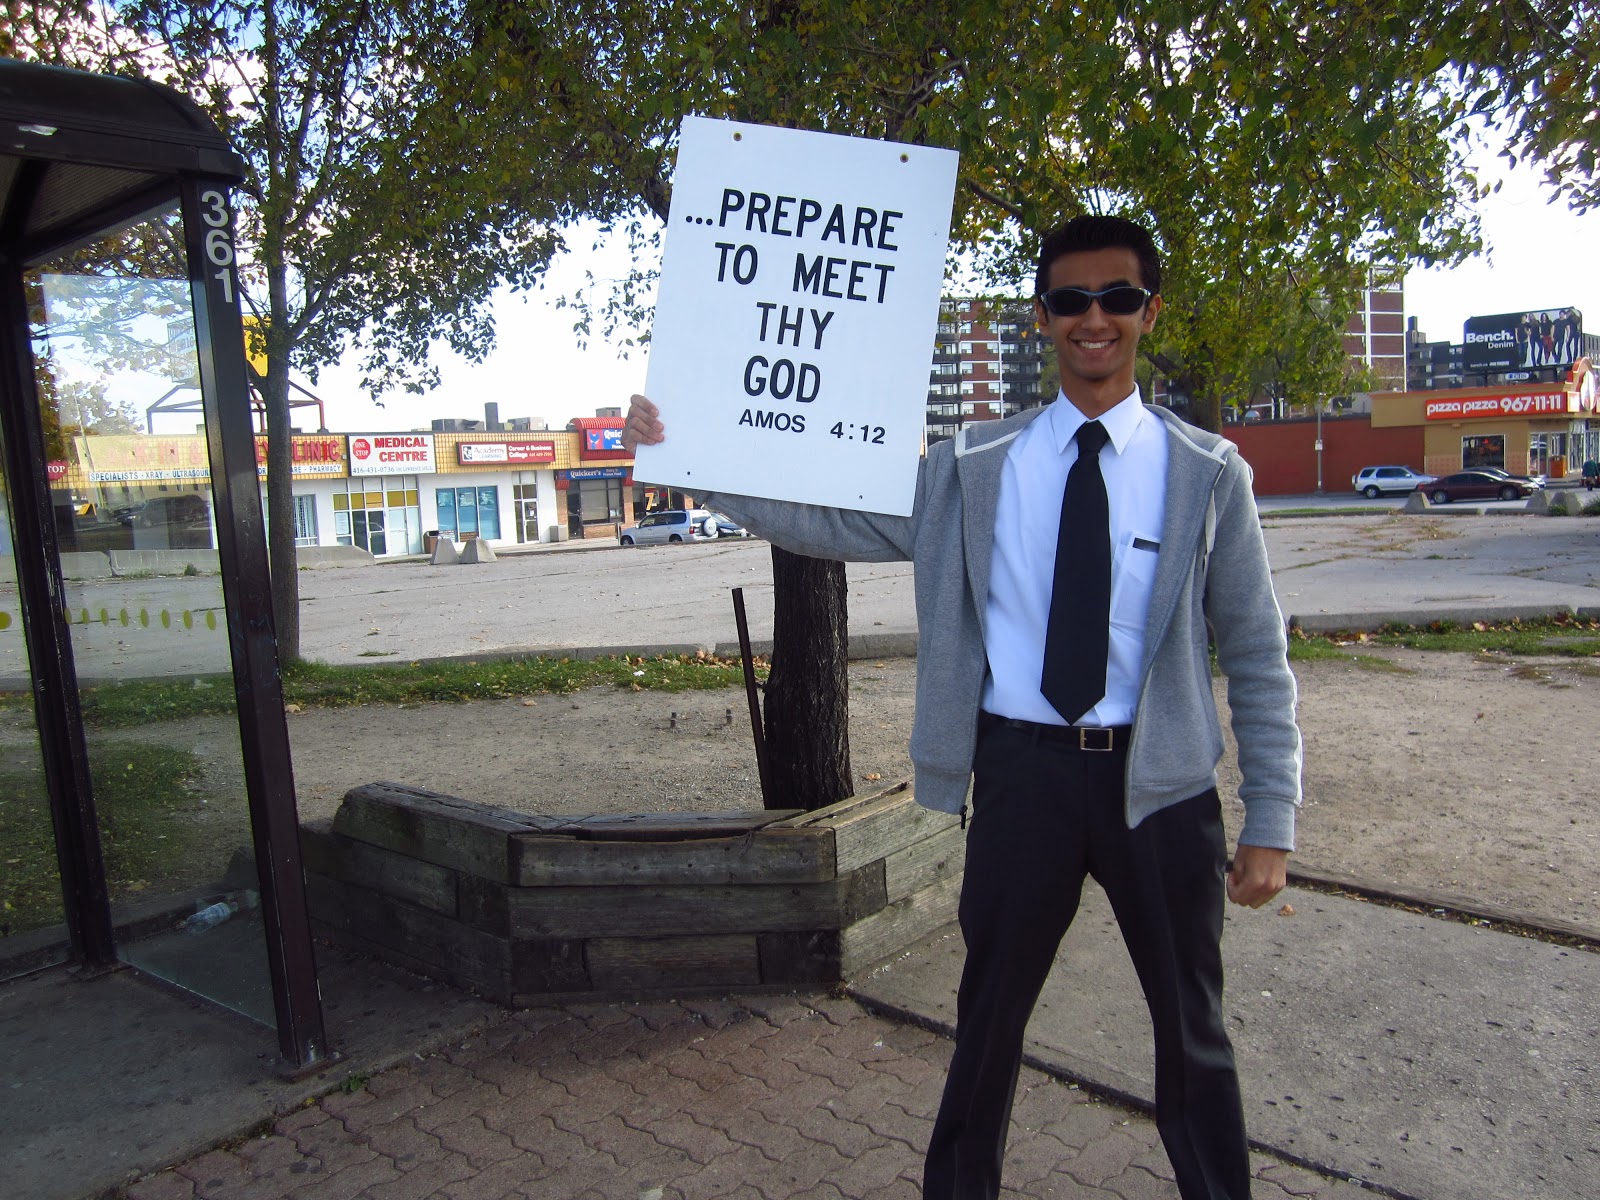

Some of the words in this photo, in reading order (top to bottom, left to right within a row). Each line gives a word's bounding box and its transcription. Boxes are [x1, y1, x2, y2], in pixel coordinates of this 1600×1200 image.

[714, 242, 758, 285] TO
[792, 253, 895, 304] MEET
[756, 301, 835, 350] THY
[1487, 341, 1514, 350] Denim
[743, 355, 821, 403] GOD
[1426, 402, 1461, 416] pizza
[1463, 400, 1498, 414] pizza
[604, 429, 623, 440] Quic
[738, 408, 806, 433] AMOS
[830, 421, 886, 445] 4:12
[292, 439, 340, 461] LINIC
[374, 437, 428, 448] MEDICAL
[474, 446, 505, 455] Academy
[379, 451, 428, 462] CENTRE
[47, 465, 66, 473] TOP
[90, 471, 139, 481] SPECIALISTS
[145, 471, 163, 479] XRAY
[172, 469, 210, 478] ULTRASOUN
[309, 465, 341, 473] PHARMACY
